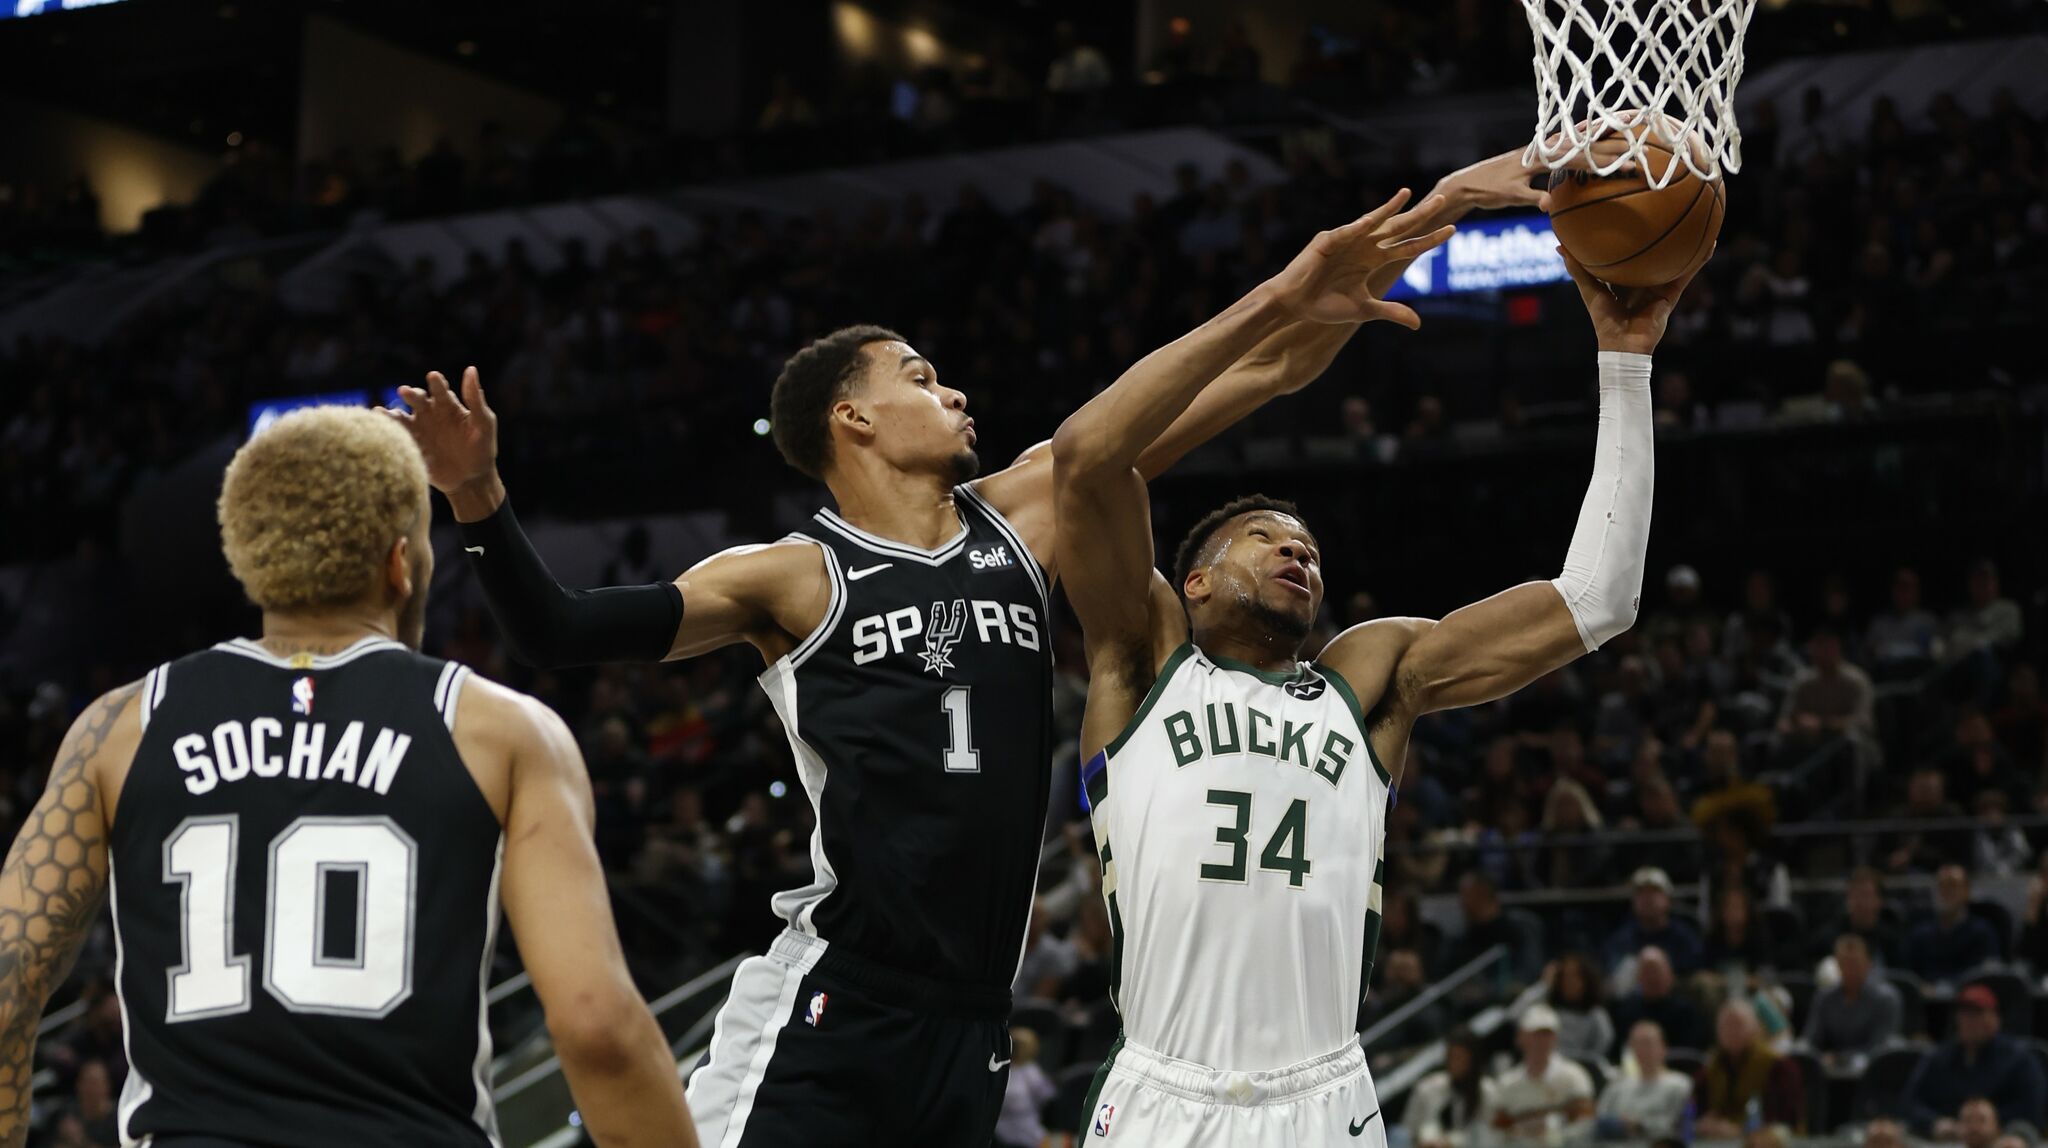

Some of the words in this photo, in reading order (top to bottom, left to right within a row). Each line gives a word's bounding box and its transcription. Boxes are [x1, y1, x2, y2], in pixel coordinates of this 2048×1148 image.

[969, 546, 1013, 569] Self.
[852, 599, 1040, 677] SPURS
[172, 717, 412, 795] SOCHAN
[941, 685, 981, 773] 1
[1163, 702, 1355, 789] BUCKS
[1199, 789, 1313, 890] 34
[162, 813, 418, 1024] 10
